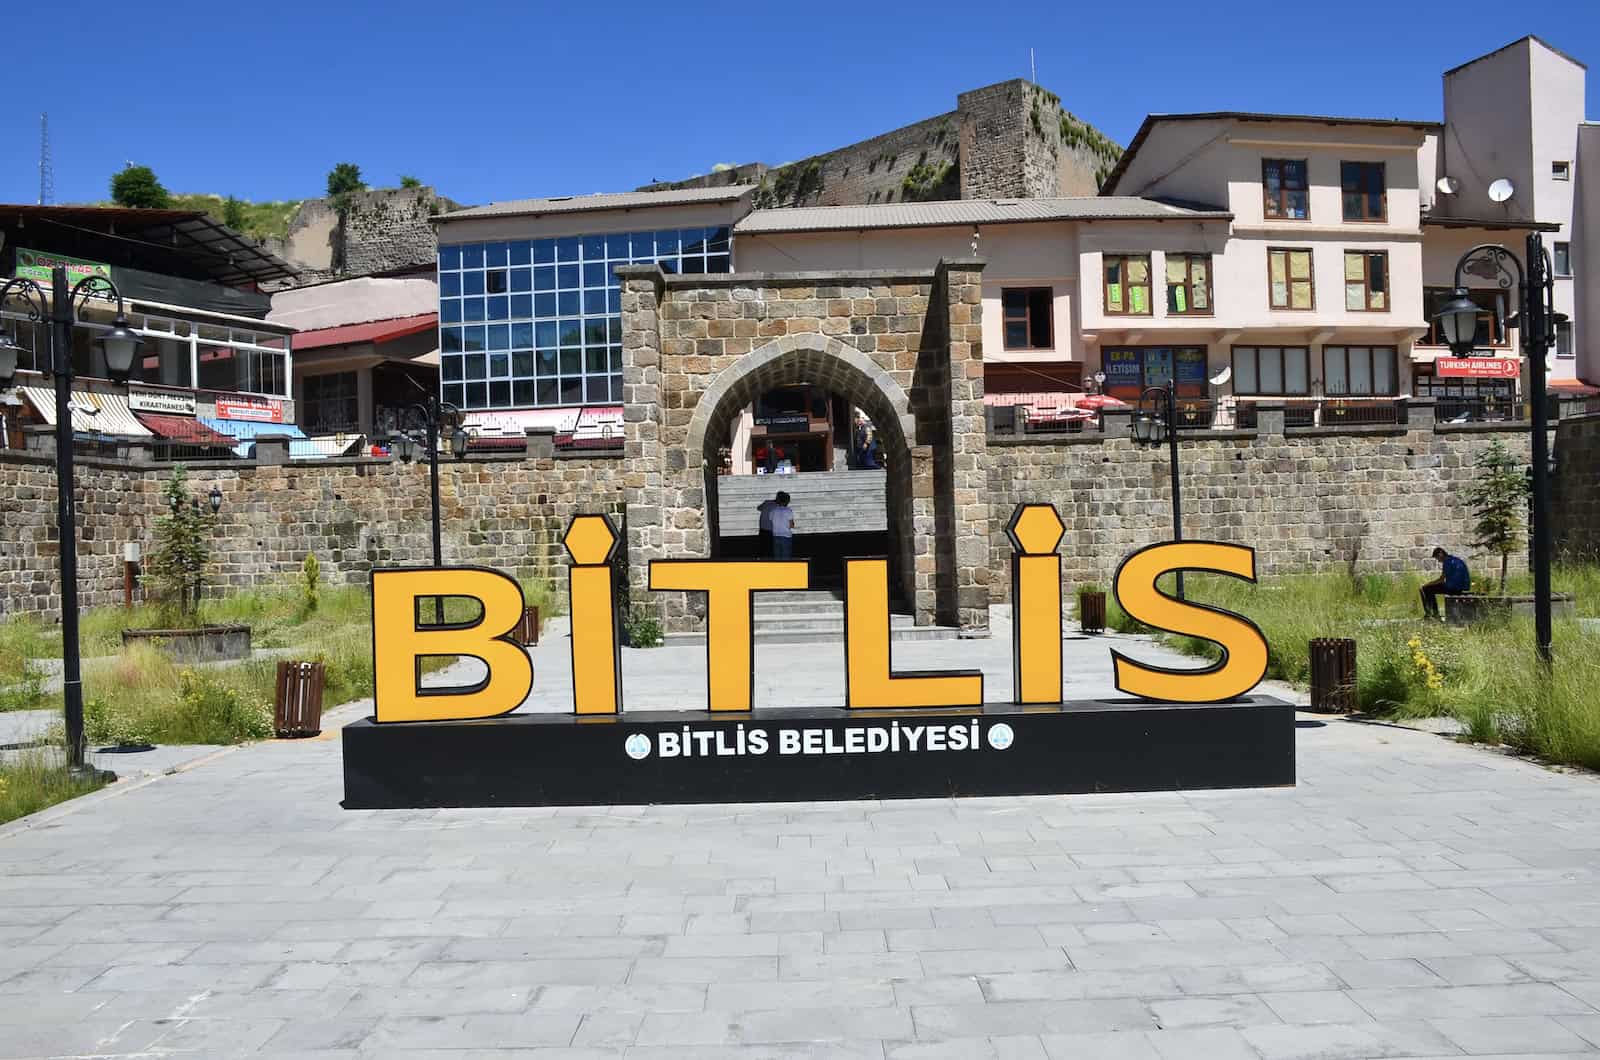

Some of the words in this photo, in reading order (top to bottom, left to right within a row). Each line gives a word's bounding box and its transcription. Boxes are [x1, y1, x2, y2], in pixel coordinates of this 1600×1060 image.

[1440, 361, 1471, 369] TURKISH
[1471, 361, 1502, 369] AIRLINES
[371, 502, 1269, 723] BİTLİS
[658, 723, 769, 758] BİTLİS
[778, 718, 980, 755] BELEDİYESİ
